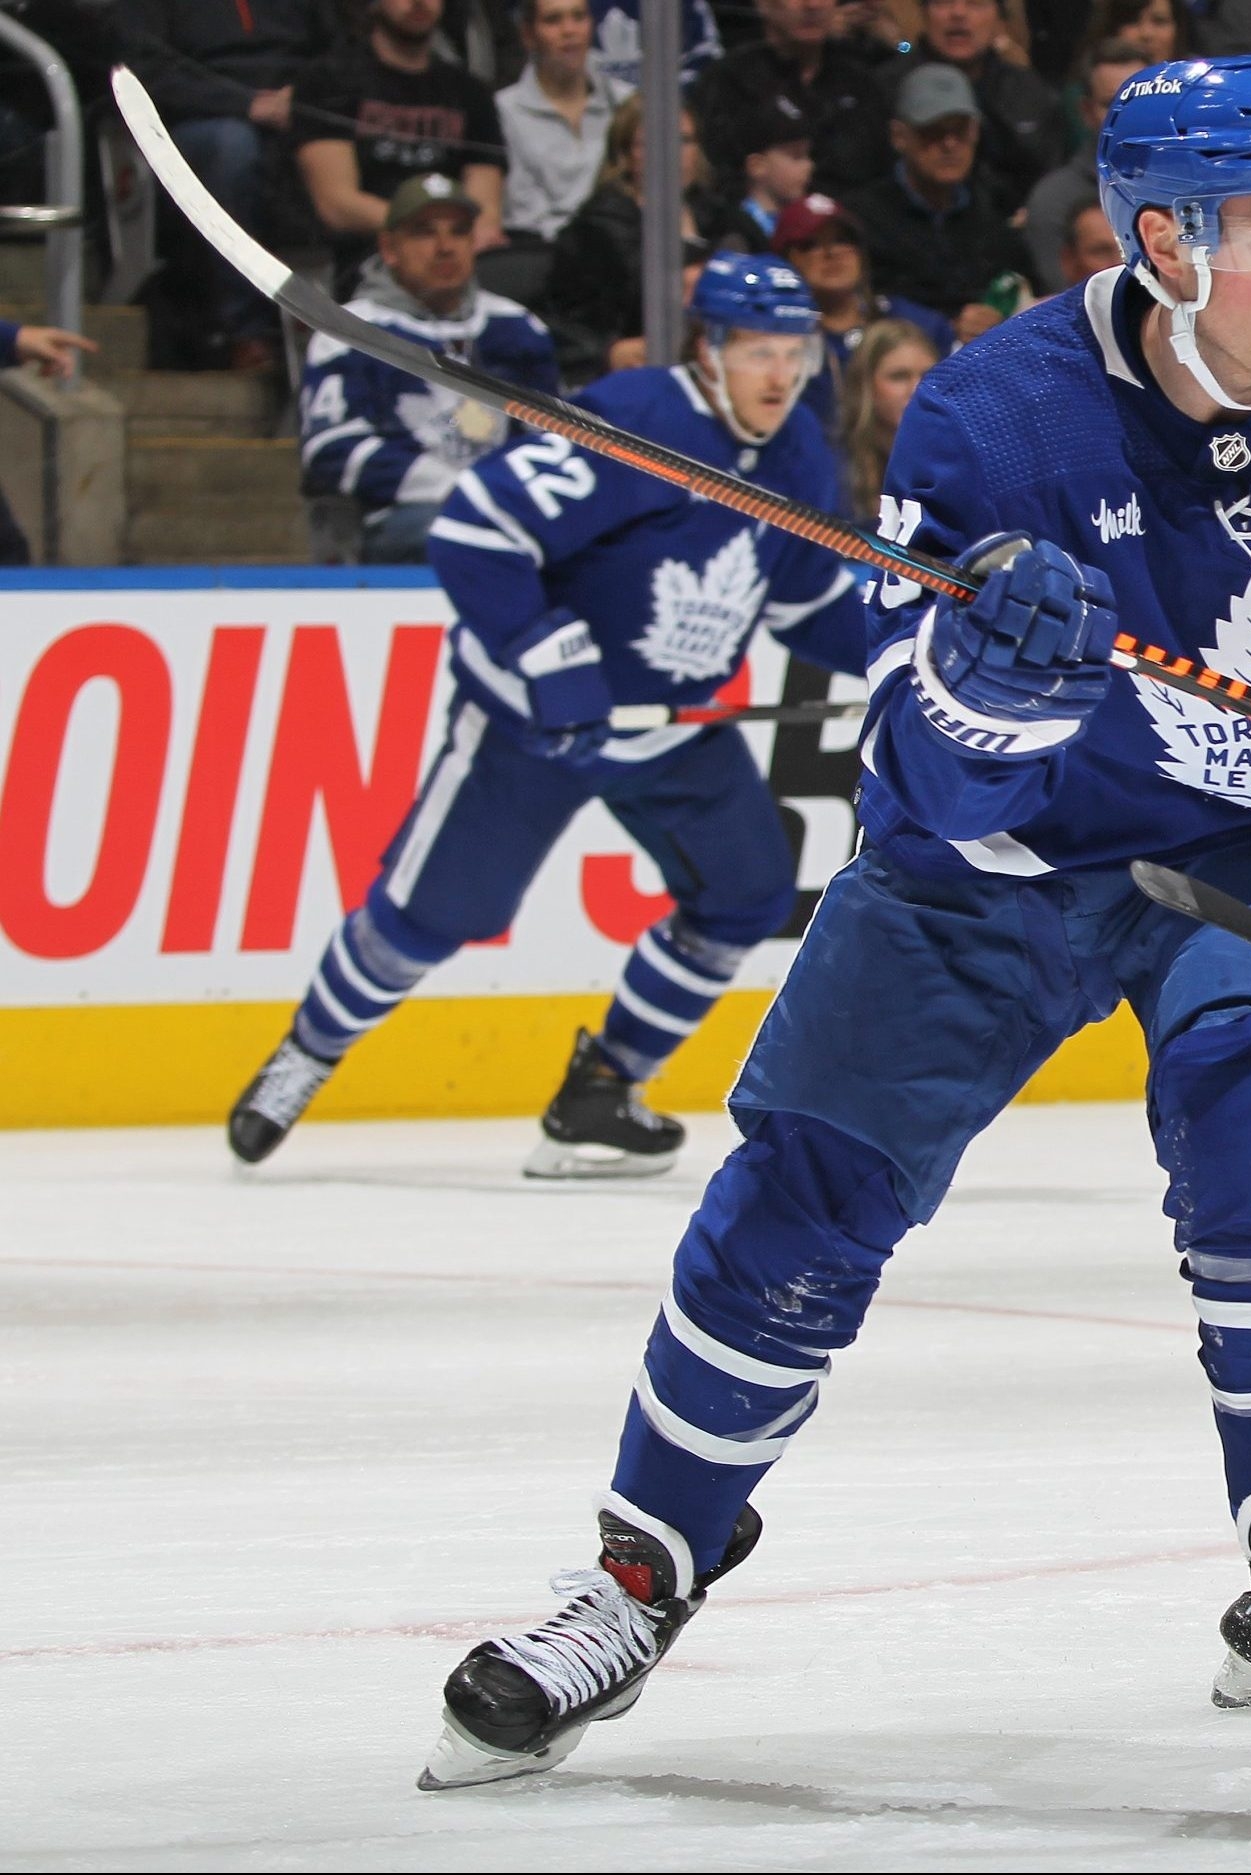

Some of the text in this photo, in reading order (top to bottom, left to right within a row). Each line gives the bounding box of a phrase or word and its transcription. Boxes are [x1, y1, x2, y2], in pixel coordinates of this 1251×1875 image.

[1134, 75, 1184, 97] TikTok
[301, 373, 348, 435] 4
[504, 432, 597, 520] 22
[1091, 492, 1146, 544] Milk
